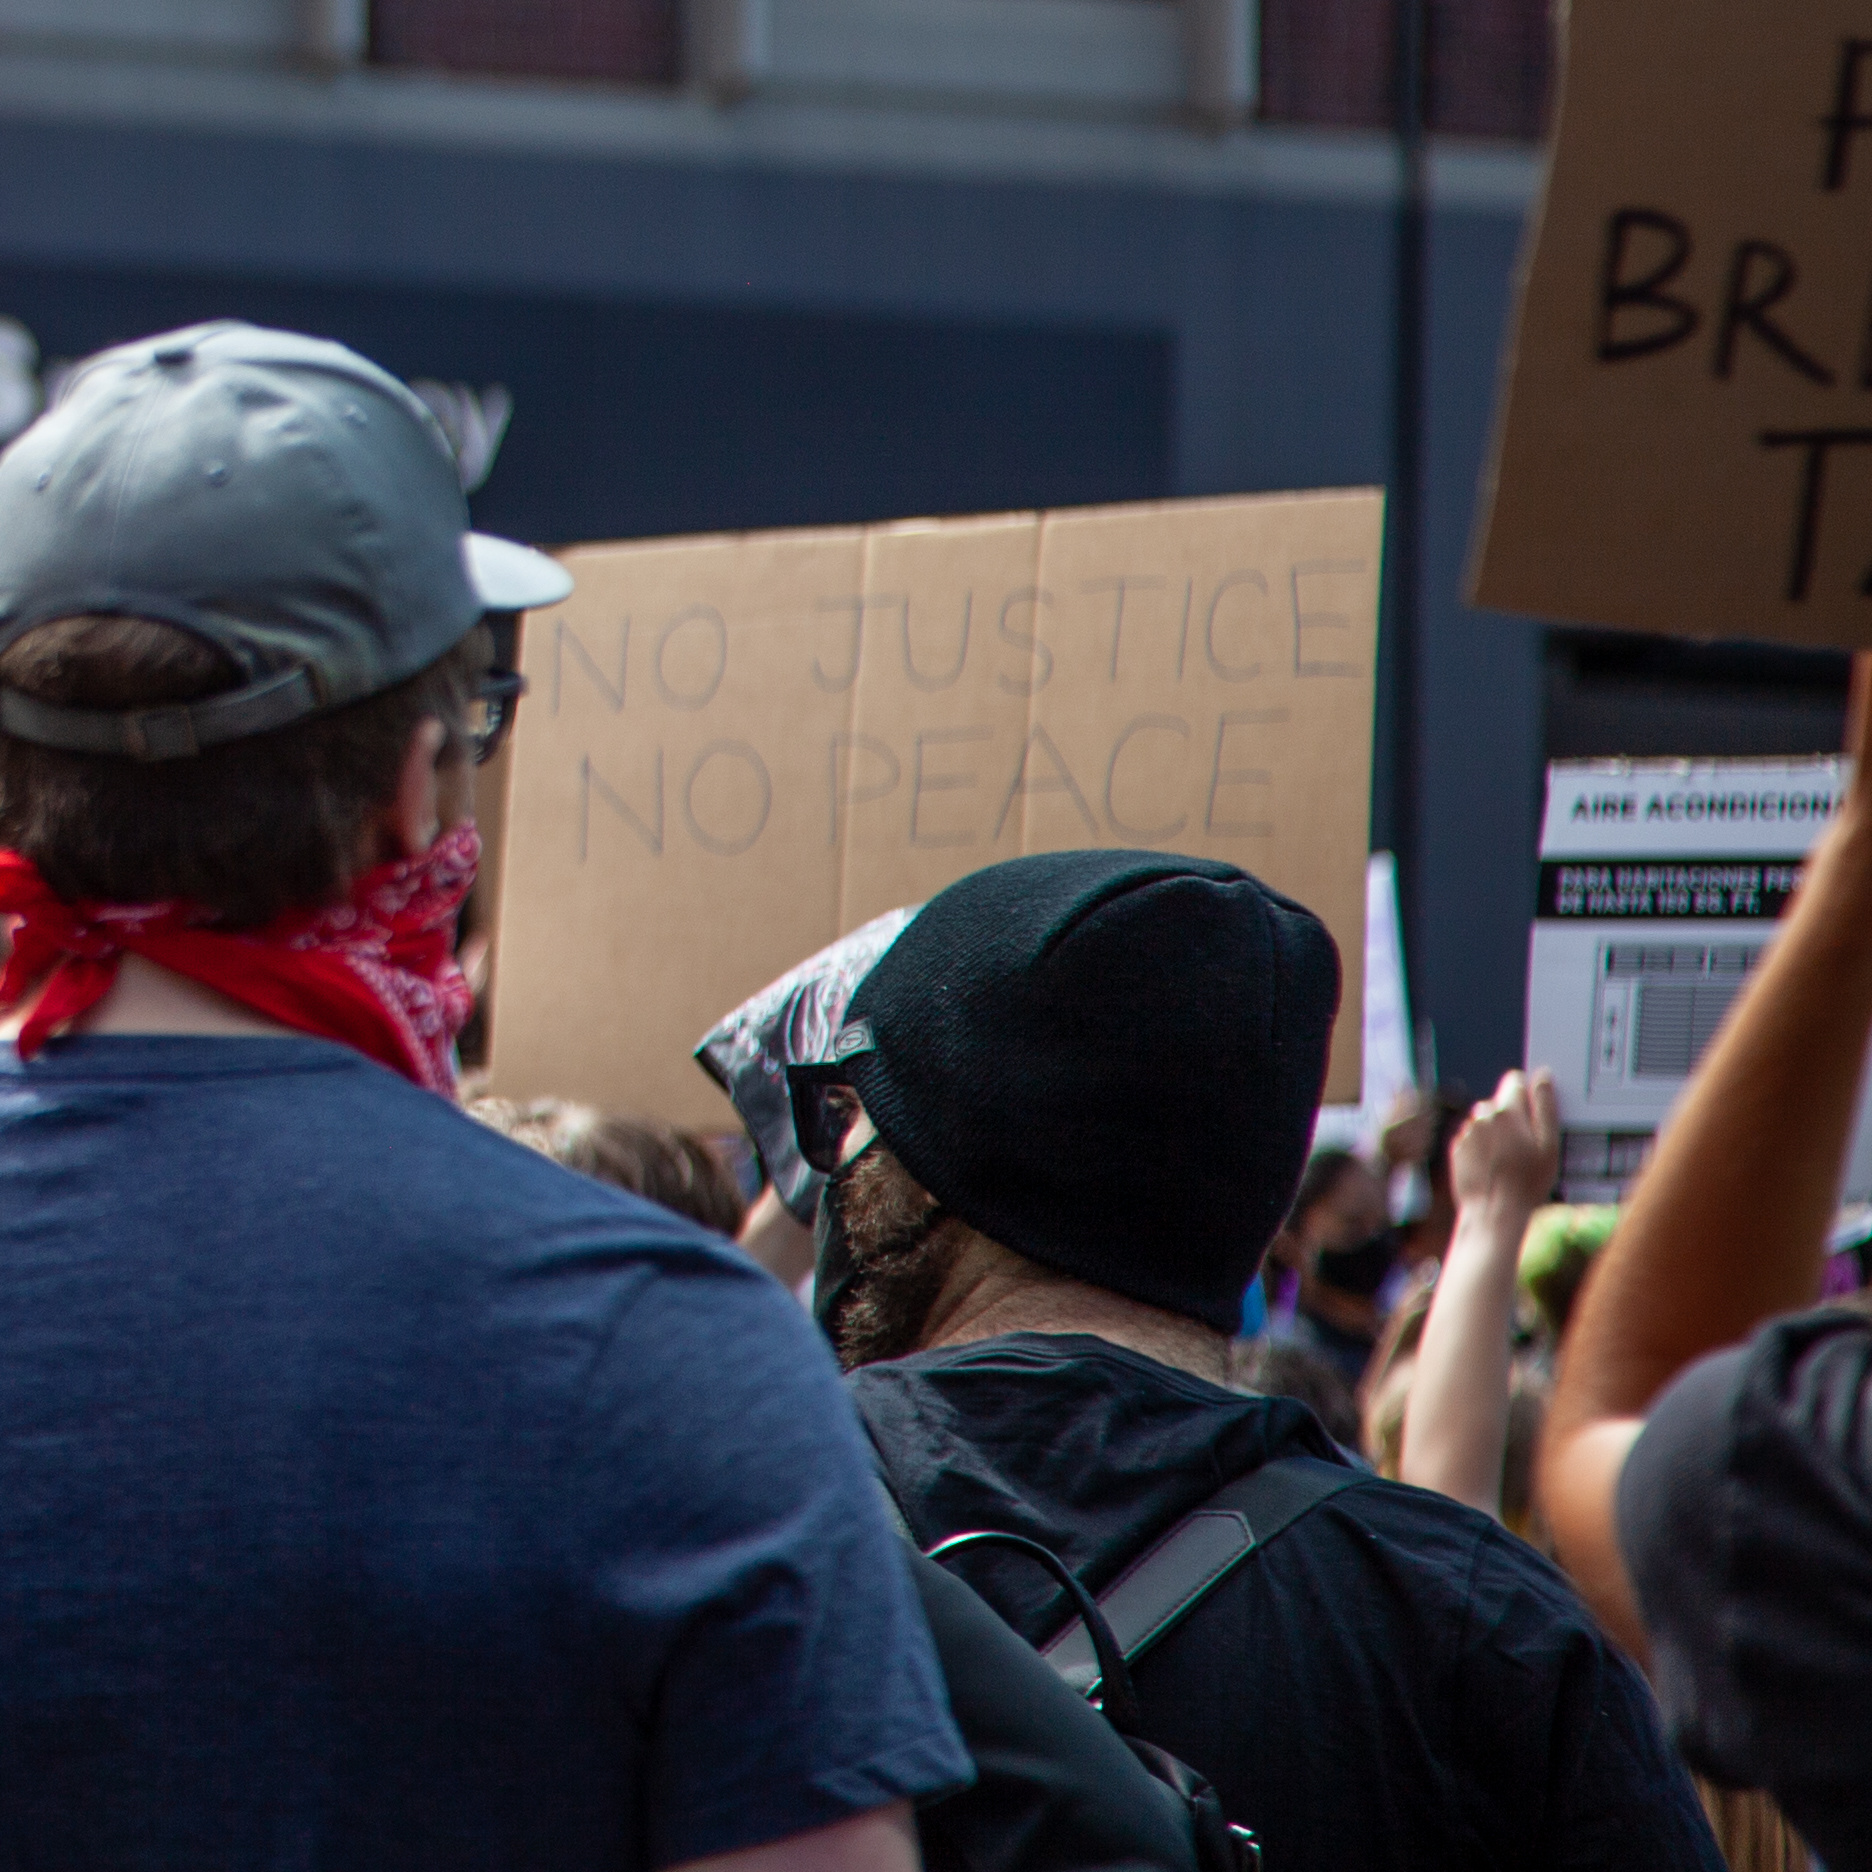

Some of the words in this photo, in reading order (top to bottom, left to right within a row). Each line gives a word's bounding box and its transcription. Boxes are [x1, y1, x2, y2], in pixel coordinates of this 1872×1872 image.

[548, 604, 729, 716] NO
[811, 557, 1369, 696] JUSTICE
[577, 737, 773, 863] NO
[827, 708, 1292, 847] PEACE
[1571, 791, 1640, 823] AIRE
